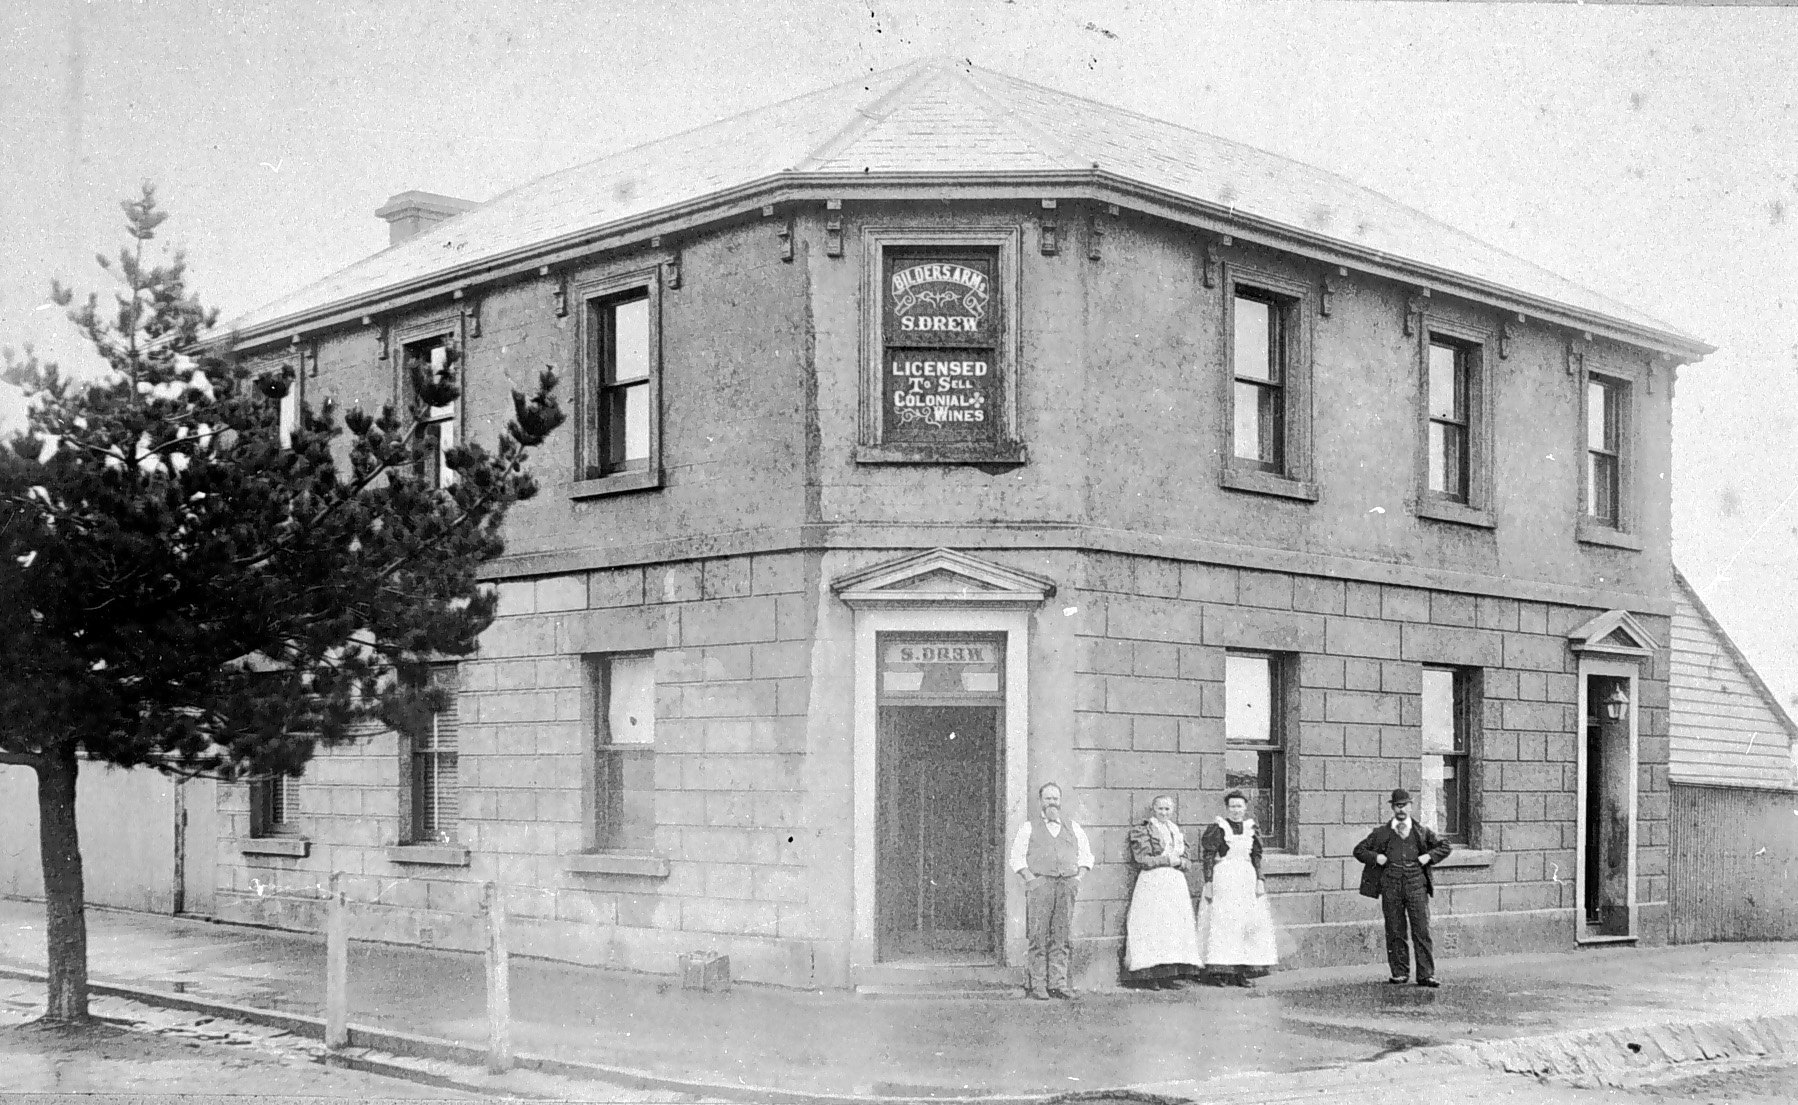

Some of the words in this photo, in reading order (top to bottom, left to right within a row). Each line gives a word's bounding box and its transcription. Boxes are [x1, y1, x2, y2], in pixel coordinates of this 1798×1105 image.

[892, 361, 987, 376] LICENSED
[937, 376, 973, 392] SELL
[893, 390, 970, 407] COLONIAL
[933, 405, 984, 421] WINES
